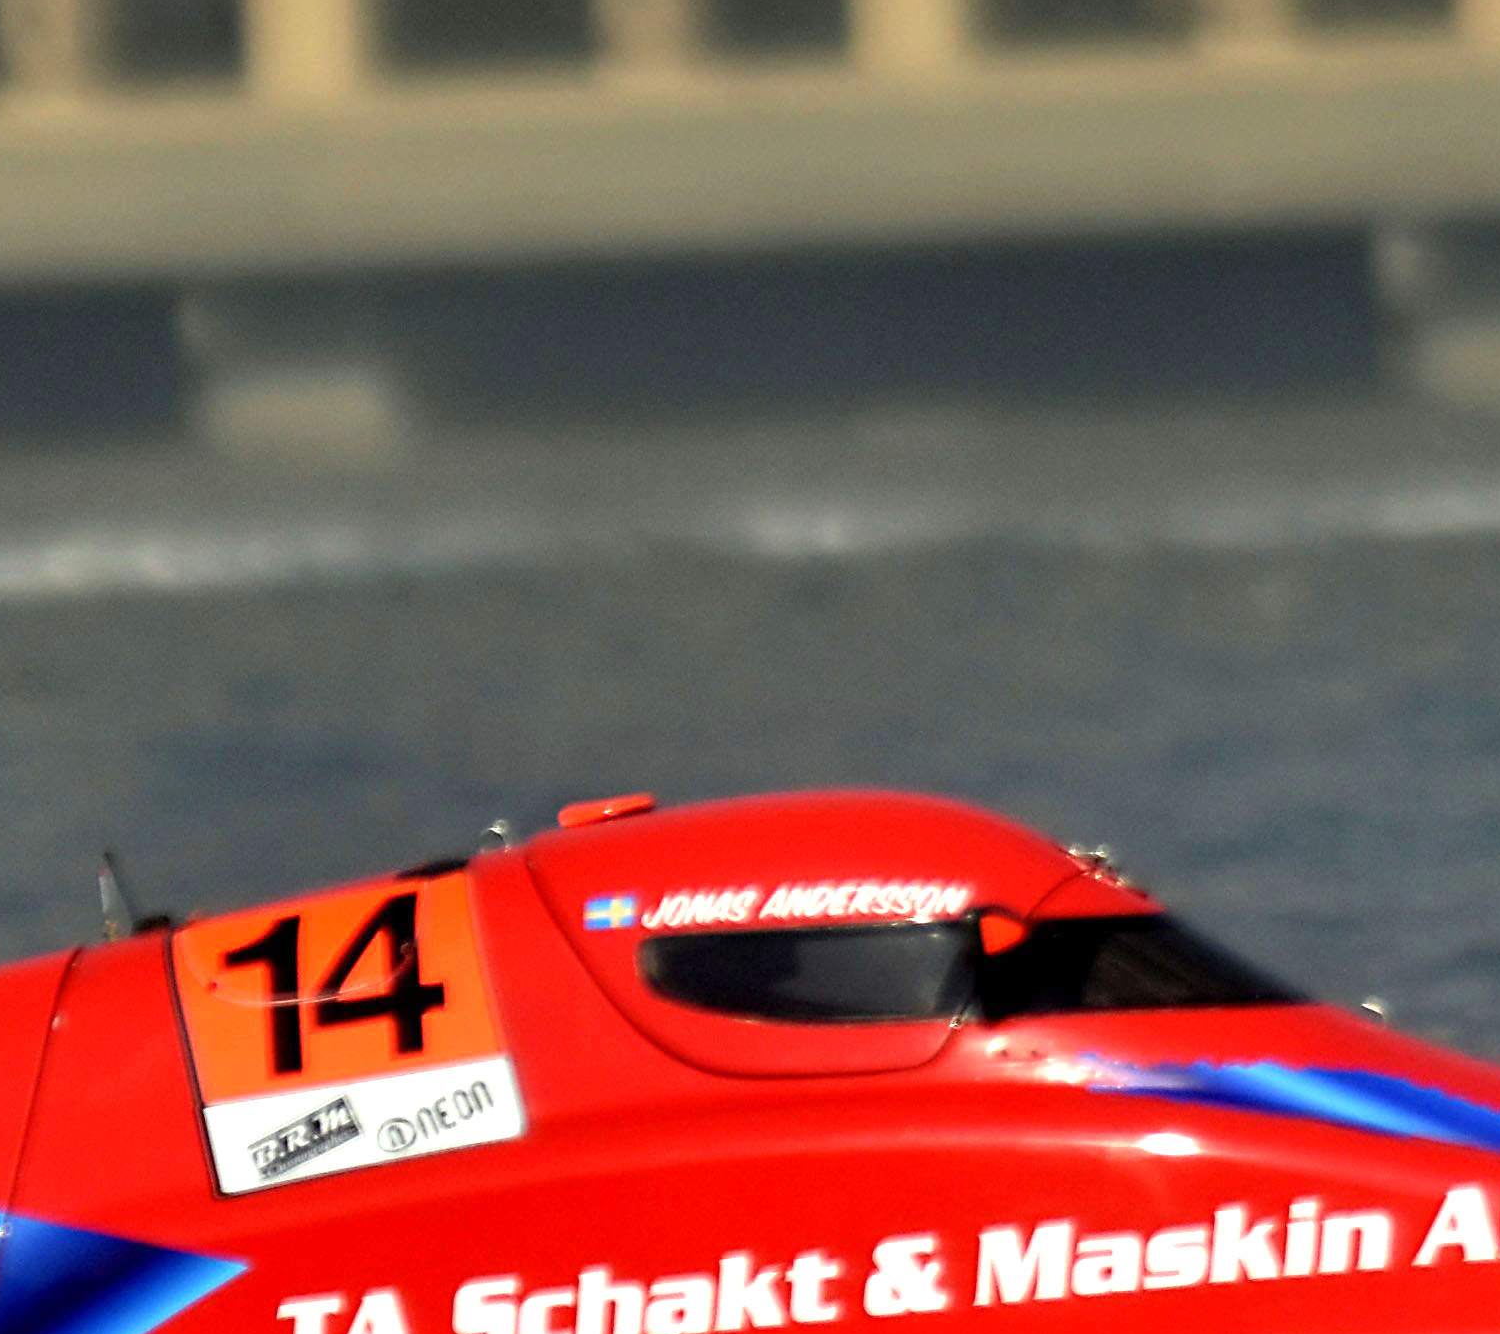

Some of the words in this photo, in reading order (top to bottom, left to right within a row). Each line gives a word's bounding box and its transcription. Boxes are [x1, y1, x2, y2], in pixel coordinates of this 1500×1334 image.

[641, 888, 757, 930] JONAS
[758, 882, 970, 921] ANDERSSON
[225, 891, 445, 1076] 14
[862, 1231, 948, 1318] &
[973, 1197, 1394, 1307] Maskin
